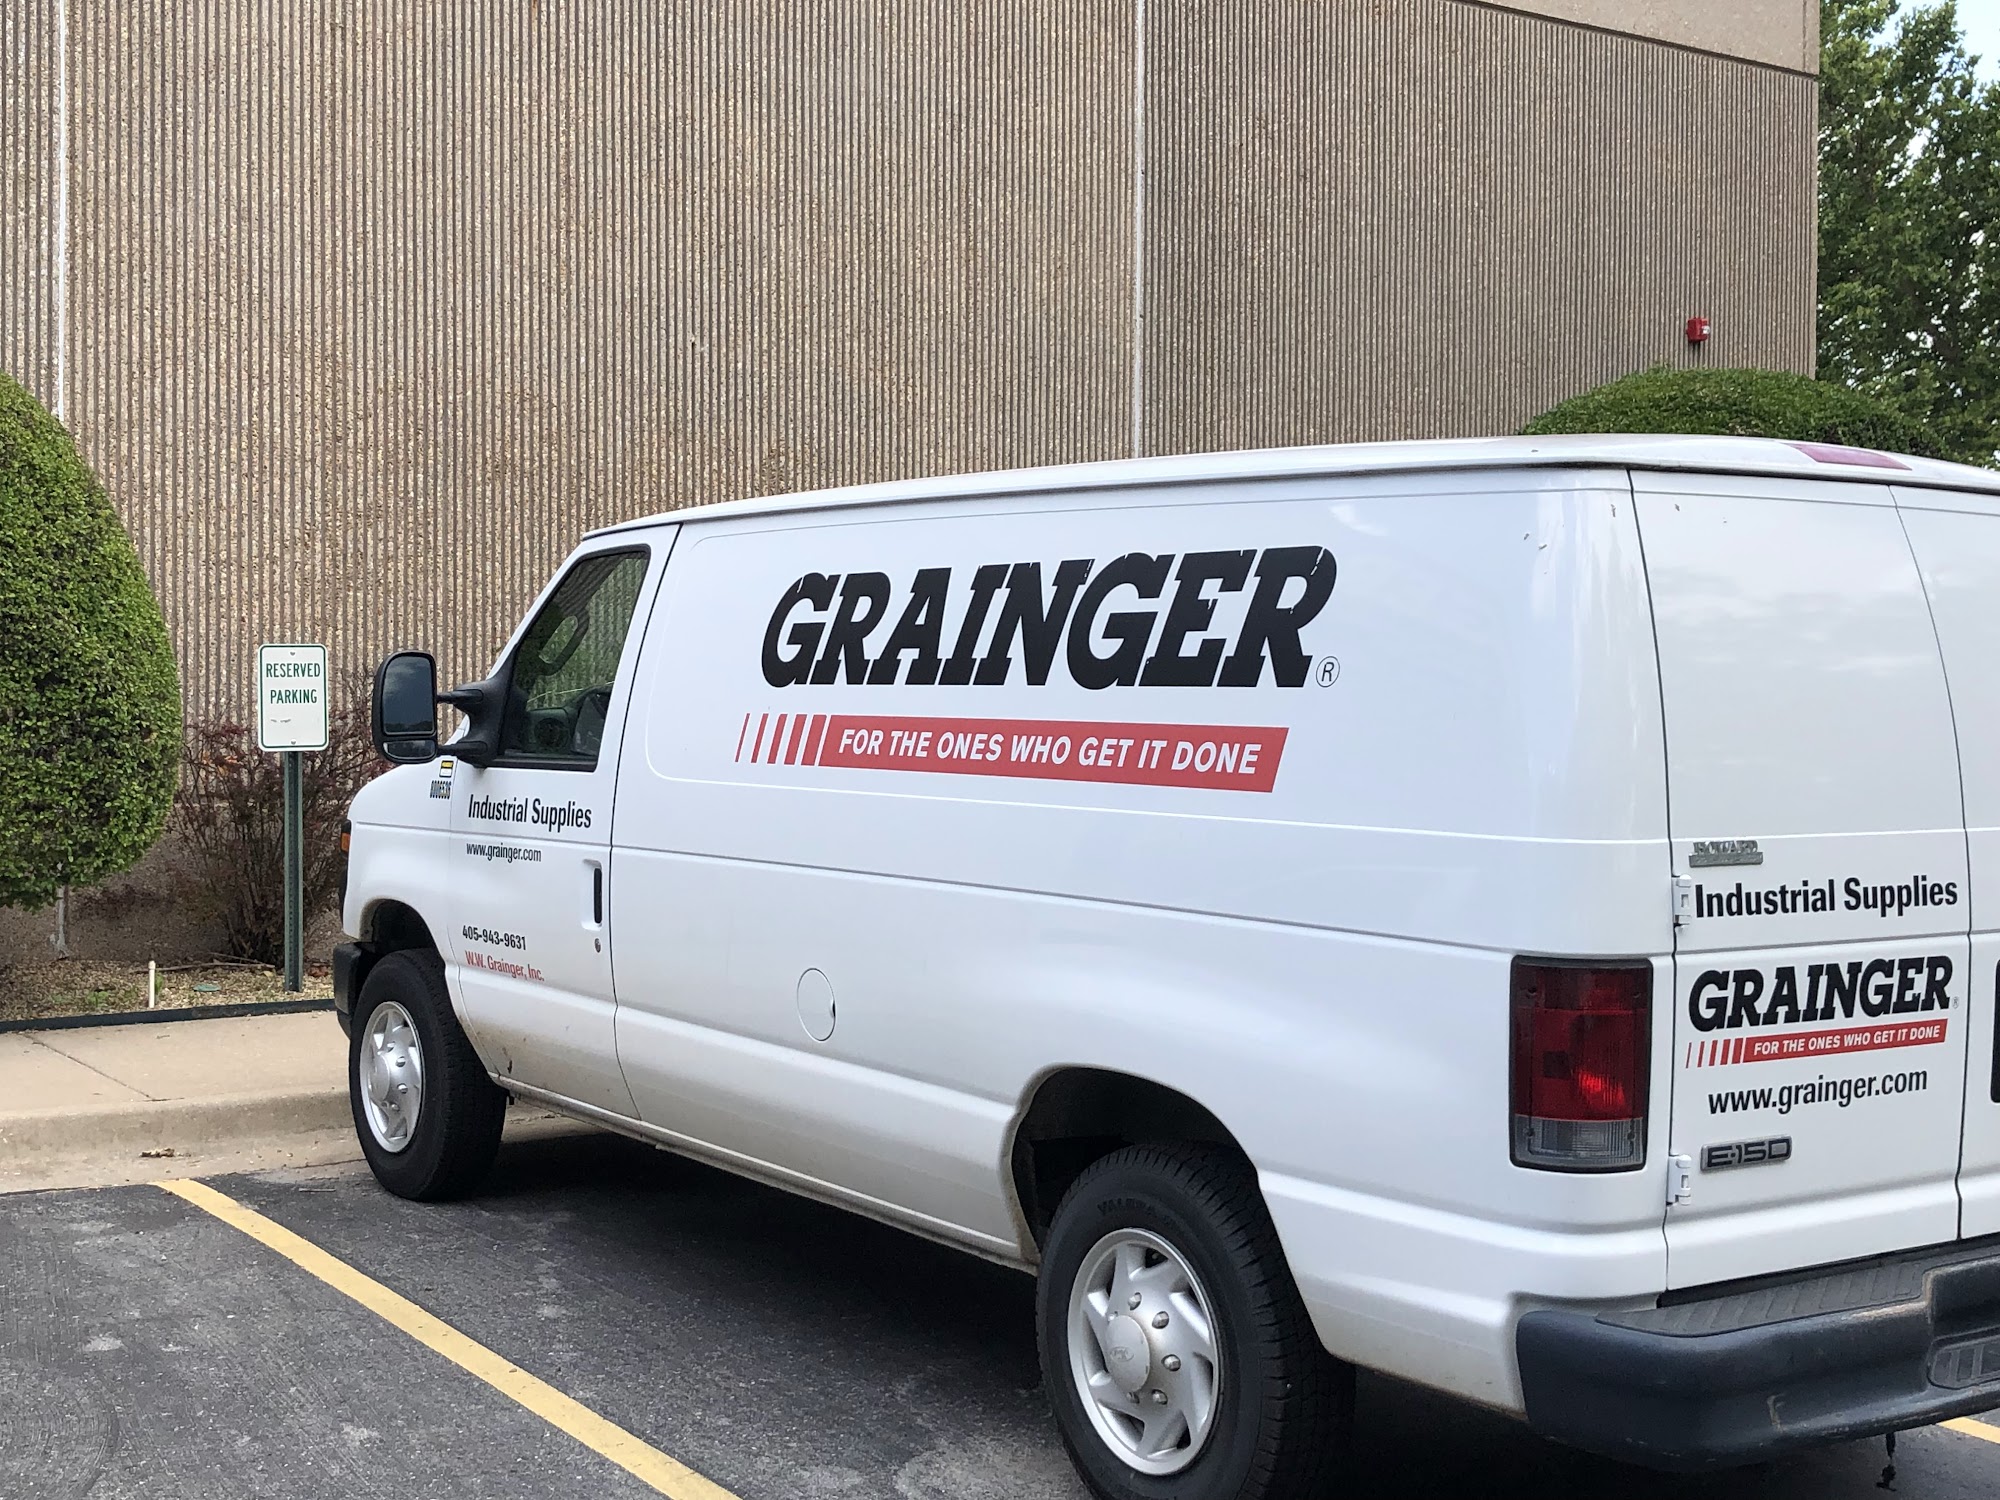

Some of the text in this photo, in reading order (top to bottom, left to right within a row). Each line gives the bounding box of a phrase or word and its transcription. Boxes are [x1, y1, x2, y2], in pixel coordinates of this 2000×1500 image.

[762, 545, 1337, 690] GRAINGER
[266, 663, 321, 678] RESERVED
[270, 689, 318, 704] PARKING
[838, 729, 1262, 774] FOR THE ONES WHO GET IT DONE
[468, 794, 592, 833] Industrial Supplies
[466, 842, 542, 863] www.grainger.com
[1695, 875, 1958, 918] Industrial Supplies
[462, 925, 526, 951] 405-943-9631
[487, 955, 527, 980] Grainger,
[527, 964, 545, 981] Inc.
[1688, 955, 1953, 1032] GRAINGER
[1753, 1025, 1941, 1056] FOR THE ONES WHO GET IT DONE
[1708, 1069, 1928, 1115] www.grainger.com
